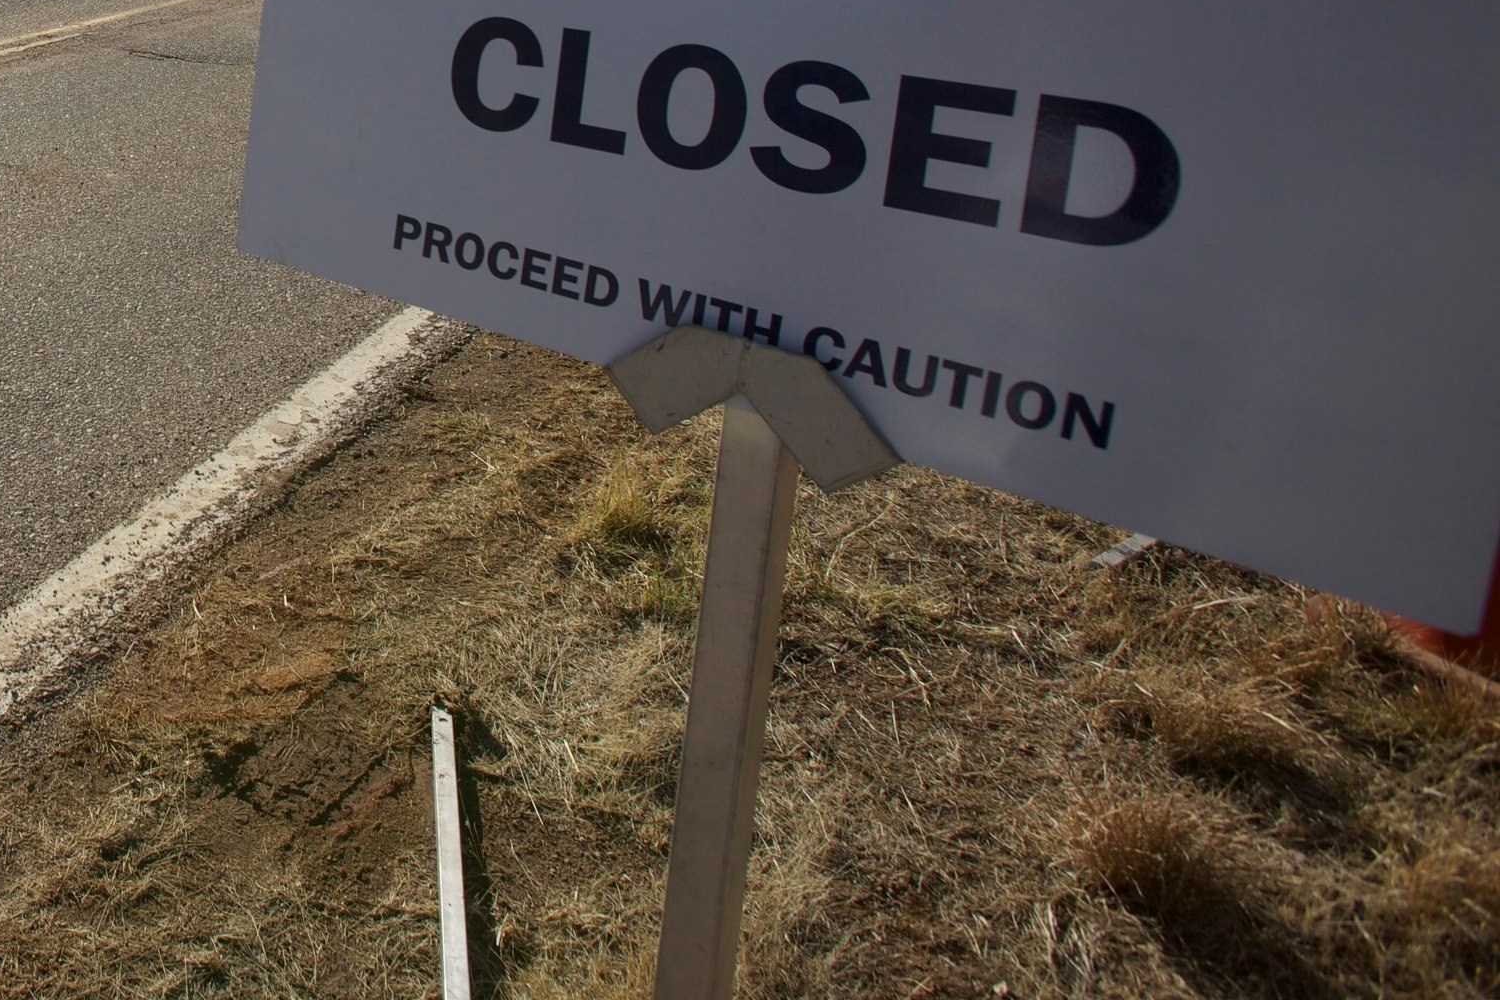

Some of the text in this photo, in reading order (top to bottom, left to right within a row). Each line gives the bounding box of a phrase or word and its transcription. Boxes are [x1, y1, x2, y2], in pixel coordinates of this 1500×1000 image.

[450, 16, 1182, 247] CLOSED
[393, 213, 1116, 451] PROCEED WITH CAUTION
